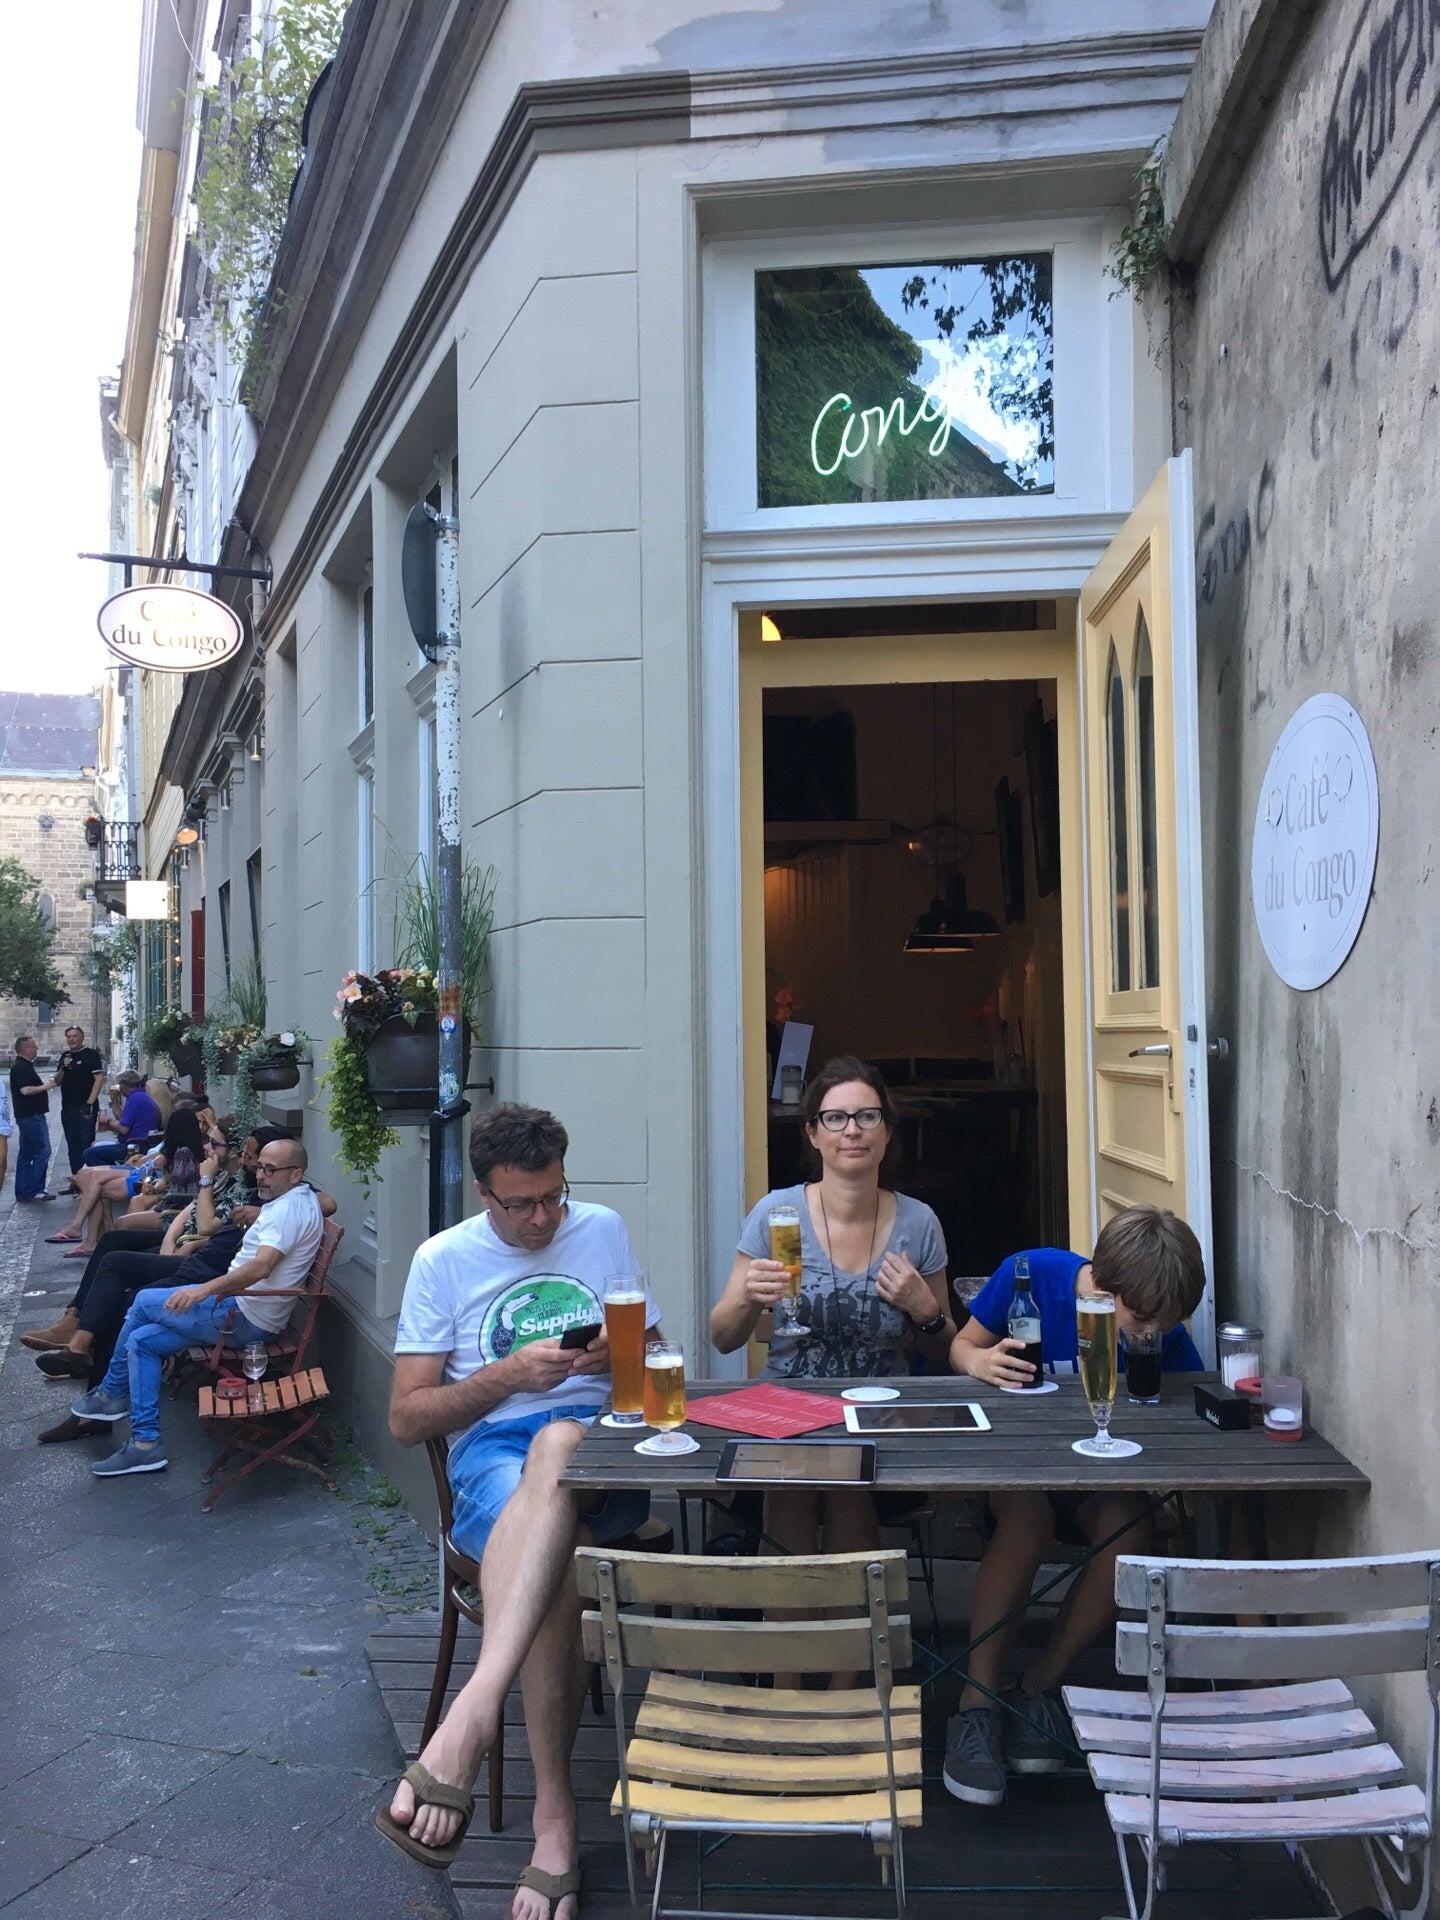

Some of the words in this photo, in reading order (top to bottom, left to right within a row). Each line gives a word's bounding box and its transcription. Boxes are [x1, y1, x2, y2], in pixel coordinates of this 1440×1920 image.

[811, 391, 953, 475] Cong
[112, 624, 141, 645] du
[1285, 752, 1330, 836] Café
[1265, 857, 1284, 912] du
[1293, 846, 1356, 918] Congo
[518, 1304, 596, 1336] Supply
